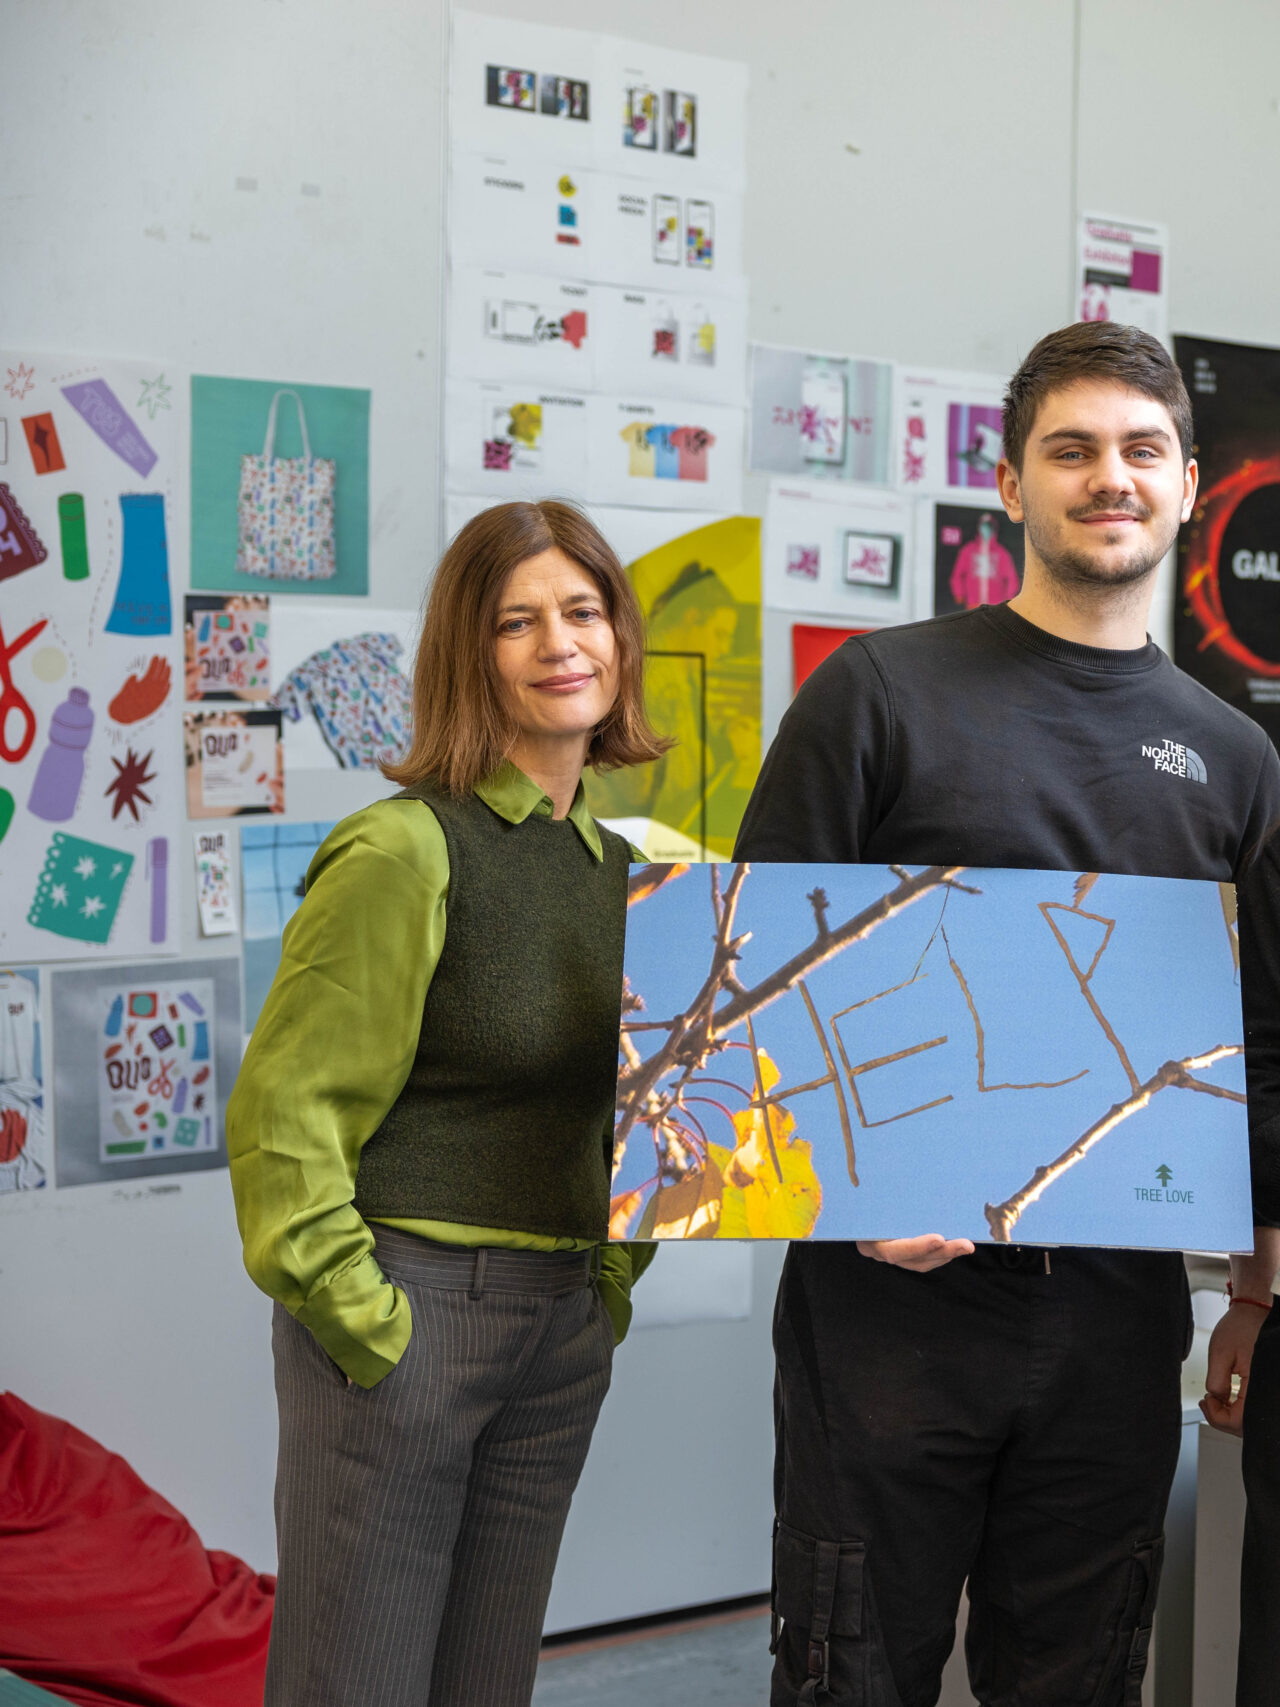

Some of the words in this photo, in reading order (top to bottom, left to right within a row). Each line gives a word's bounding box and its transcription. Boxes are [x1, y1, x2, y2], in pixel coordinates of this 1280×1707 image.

[1142, 745, 1187, 767] NORTH
[1162, 739, 1186, 756] THE
[1155, 759, 1186, 778] FACE
[1134, 1187, 1163, 1202] TREE
[1165, 1189, 1195, 1204] LOVE
